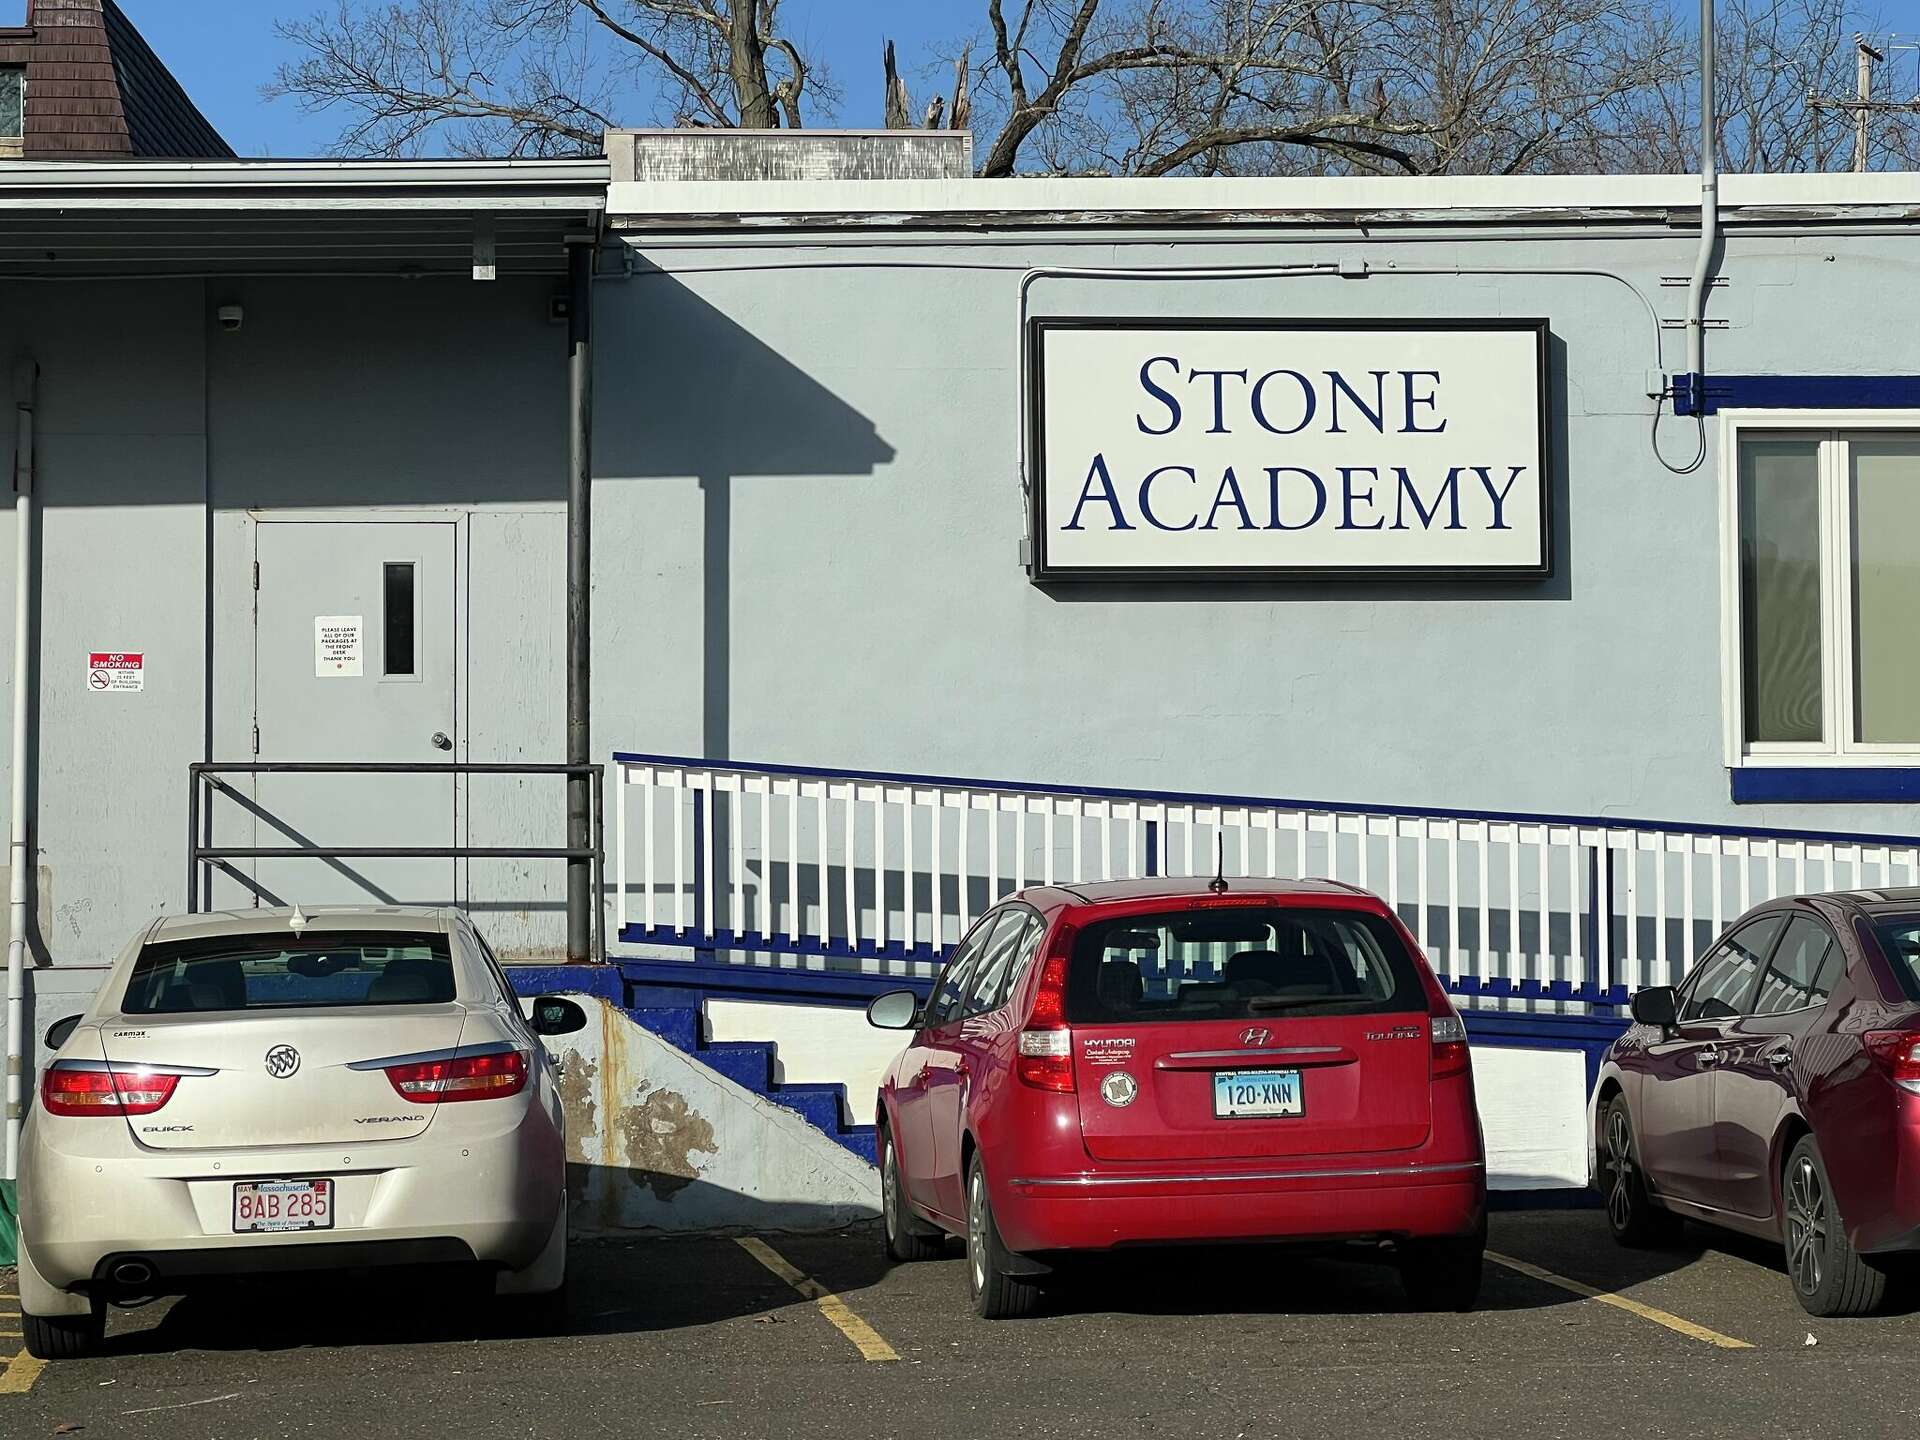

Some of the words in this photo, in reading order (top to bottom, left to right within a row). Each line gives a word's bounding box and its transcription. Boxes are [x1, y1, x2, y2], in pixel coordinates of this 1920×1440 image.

[1136, 356, 1447, 435] STONE
[1060, 453, 1527, 531] ACADEMY
[1084, 1038, 1136, 1047] HYUNDAI
[353, 1115, 425, 1125] VERANO
[142, 1125, 195, 1133] BUICK
[237, 1185, 252, 1193] MAY
[240, 1194, 280, 1219] 8AB
[287, 1192, 327, 1217] 285
